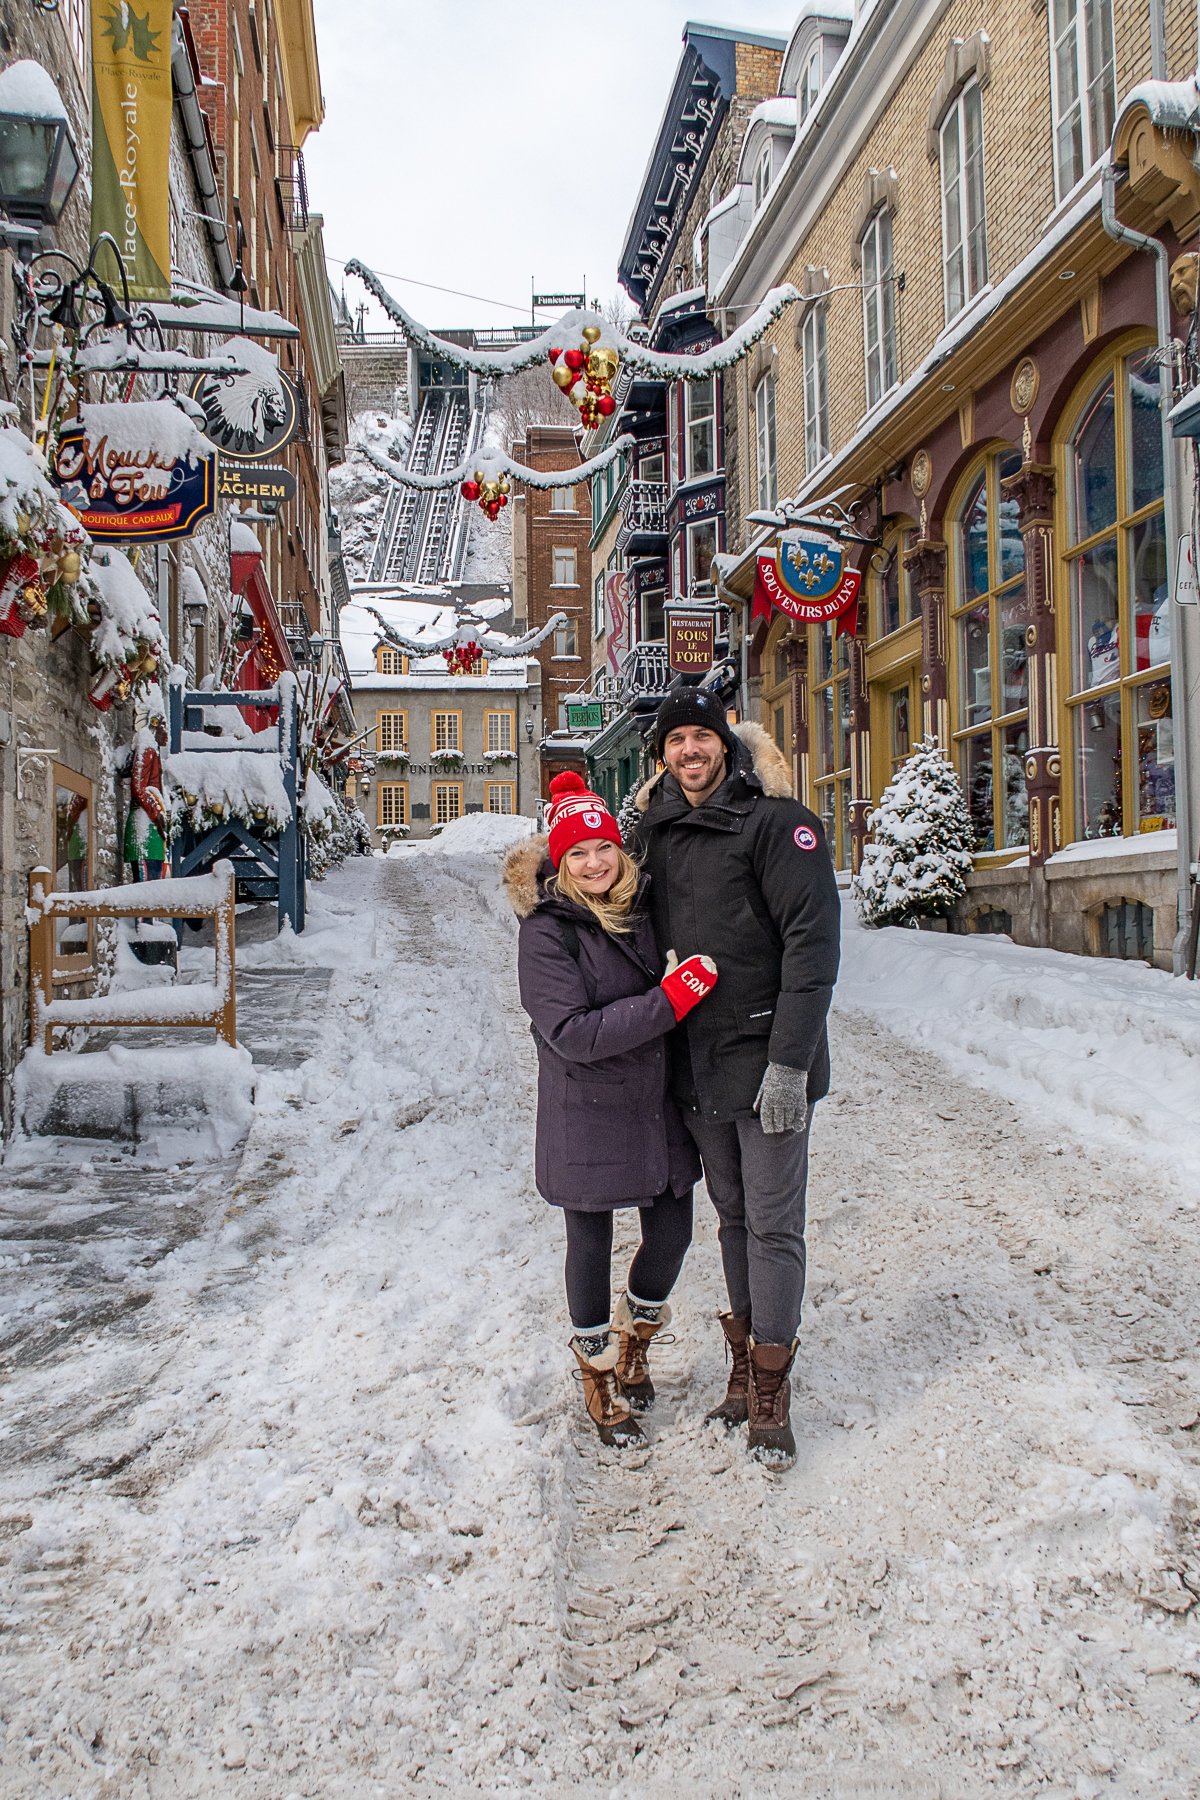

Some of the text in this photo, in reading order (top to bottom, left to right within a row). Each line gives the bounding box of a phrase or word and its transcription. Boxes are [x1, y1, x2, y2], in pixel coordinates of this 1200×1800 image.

[538, 296, 580, 304] Funiculaire
[223, 471, 241, 482] LE
[90, 471, 168, 505] à Feu
[217, 482, 286, 497] ACHEM
[82, 512, 174, 525] BOUTIQUE CADEAUX
[761, 564, 856, 618] SOUVENIRS DU LYS
[671, 620, 712, 628] RESTAURANT
[676, 630, 709, 642] SOUS
[687, 642, 698, 650] LE
[674, 651, 711, 663] FORT
[400, 763, 495, 775] FUNICULAIRE
[680, 970, 710, 997] CAN
